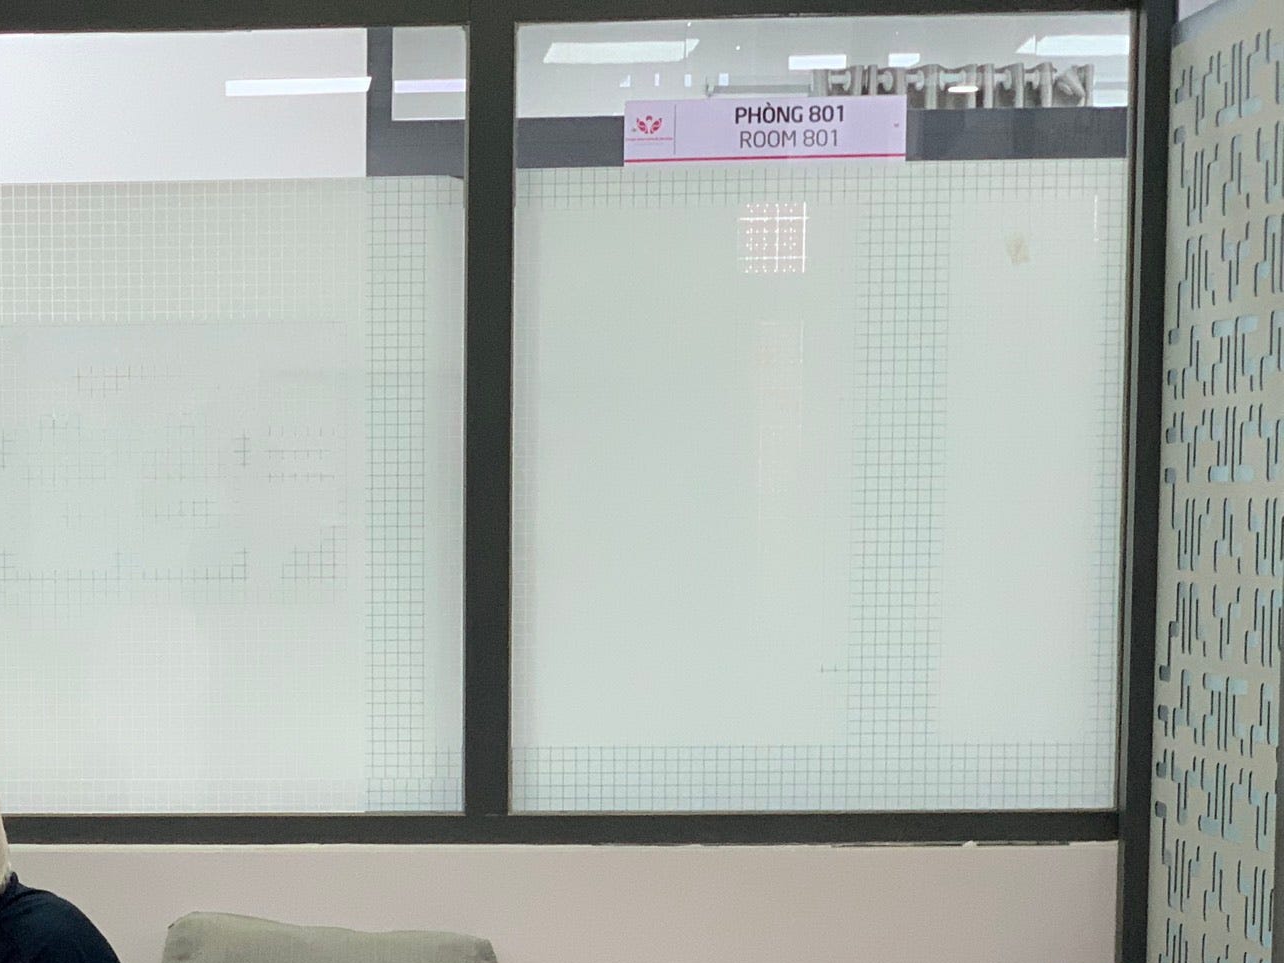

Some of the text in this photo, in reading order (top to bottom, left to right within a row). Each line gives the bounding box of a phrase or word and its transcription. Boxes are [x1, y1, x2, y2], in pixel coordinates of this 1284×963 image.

[734, 101, 845, 124] PHÒNG 801
[739, 129, 838, 149] ROOM 801
